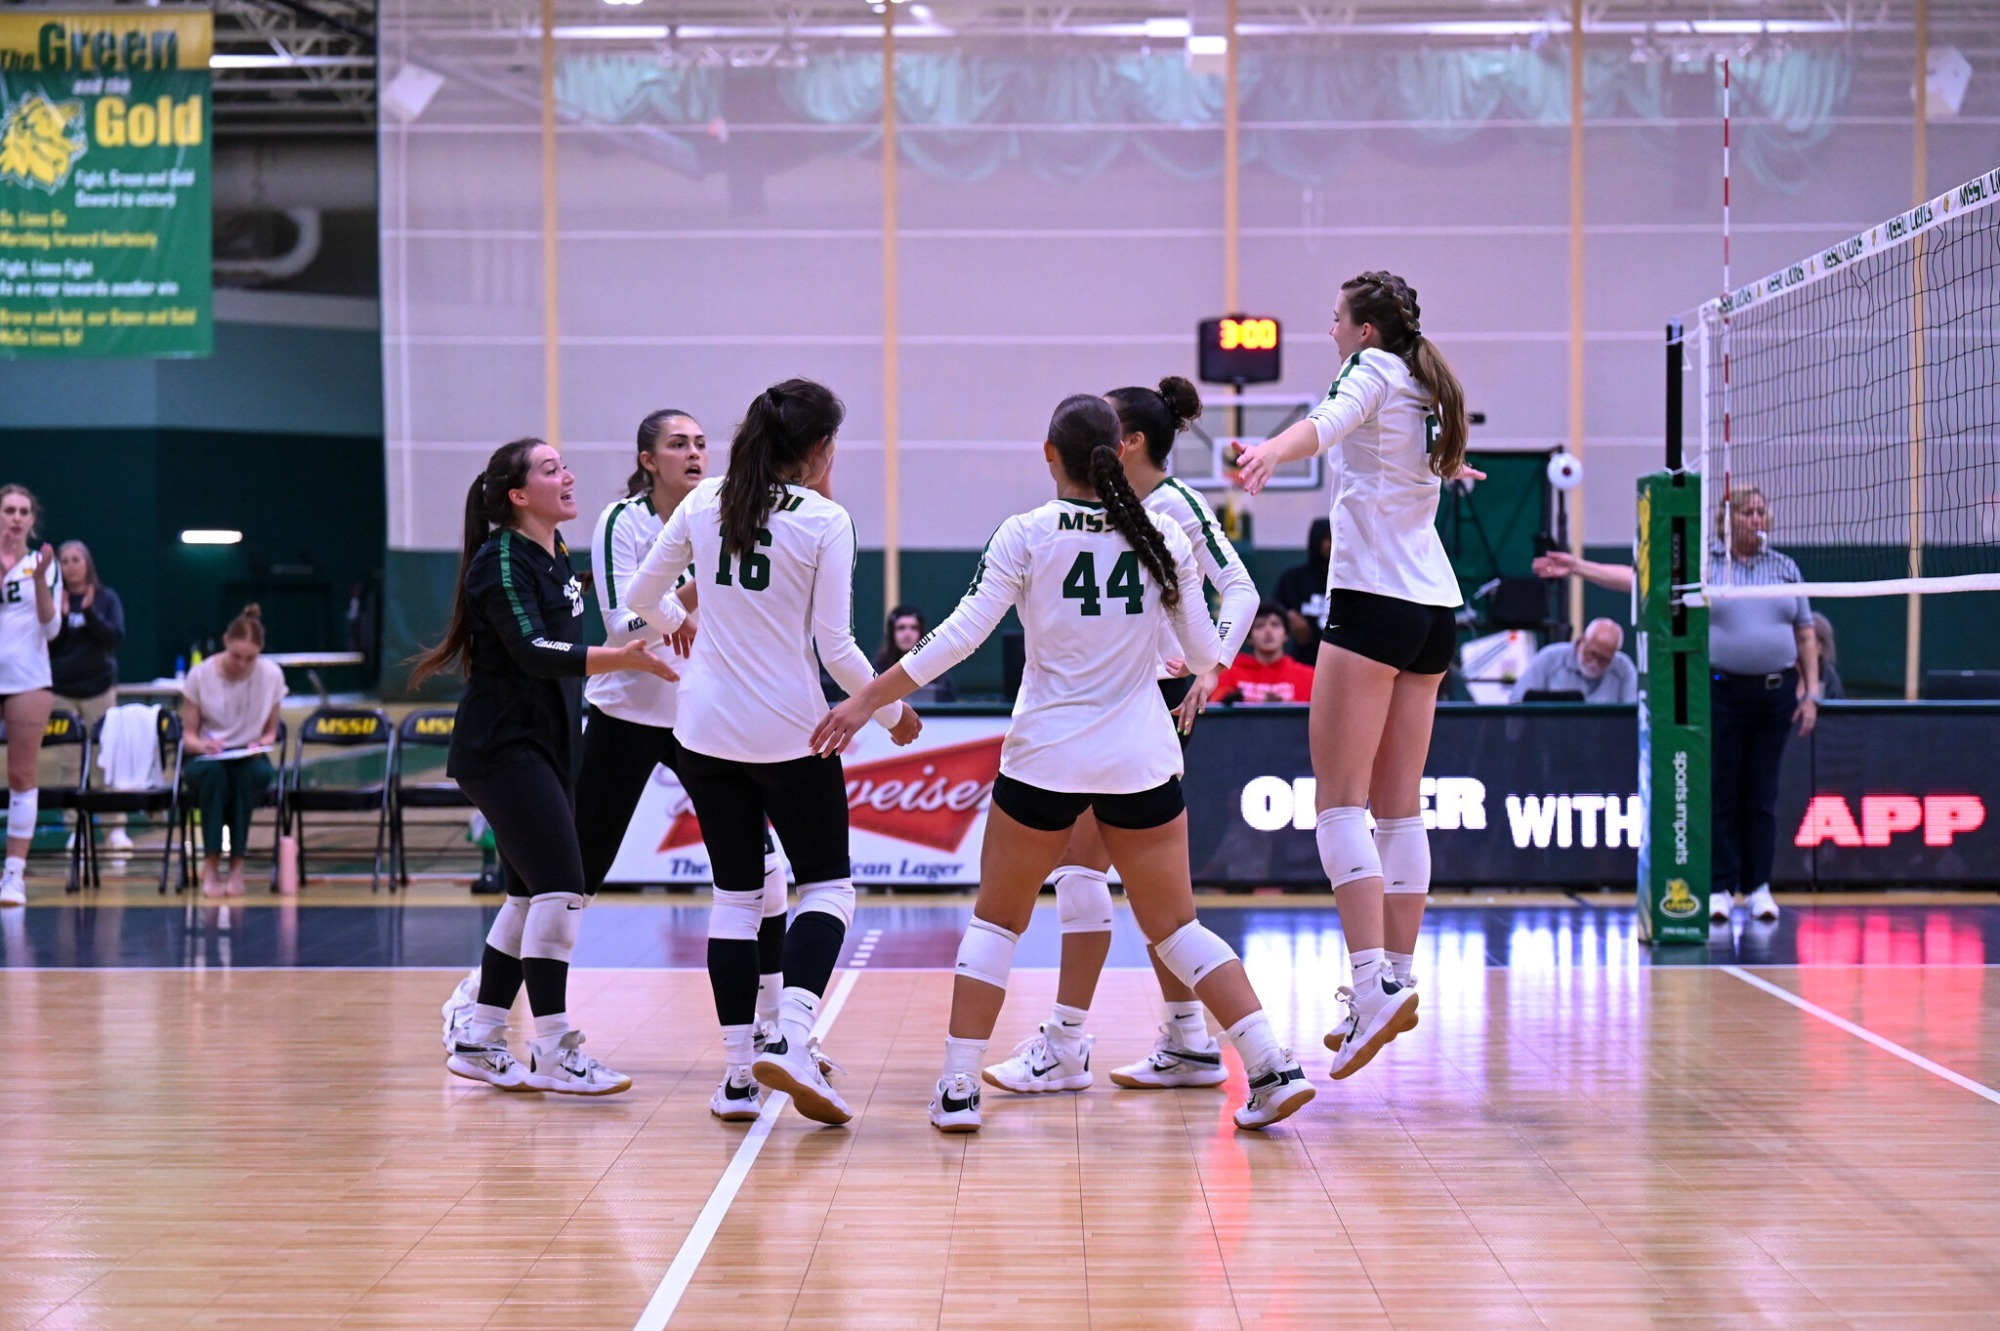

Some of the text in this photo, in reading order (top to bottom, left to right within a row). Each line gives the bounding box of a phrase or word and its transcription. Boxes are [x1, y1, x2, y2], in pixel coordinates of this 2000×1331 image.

[39, 22, 178, 71] Green
[95, 96, 203, 147] Gold
[109, 168, 144, 187] Green
[147, 169, 168, 187] and
[170, 168, 195, 187] Gold
[1219, 318, 1277, 350] 3:00
[716, 524, 772, 592] 16
[1063, 549, 1144, 616] 44
[316, 717, 378, 736] MSSU
[1505, 794, 1642, 849] WITH
[1672, 751, 1689, 865] sports imports
[1793, 794, 1986, 847] APP
[671, 858, 709, 877] The
[899, 858, 963, 880] Lager
